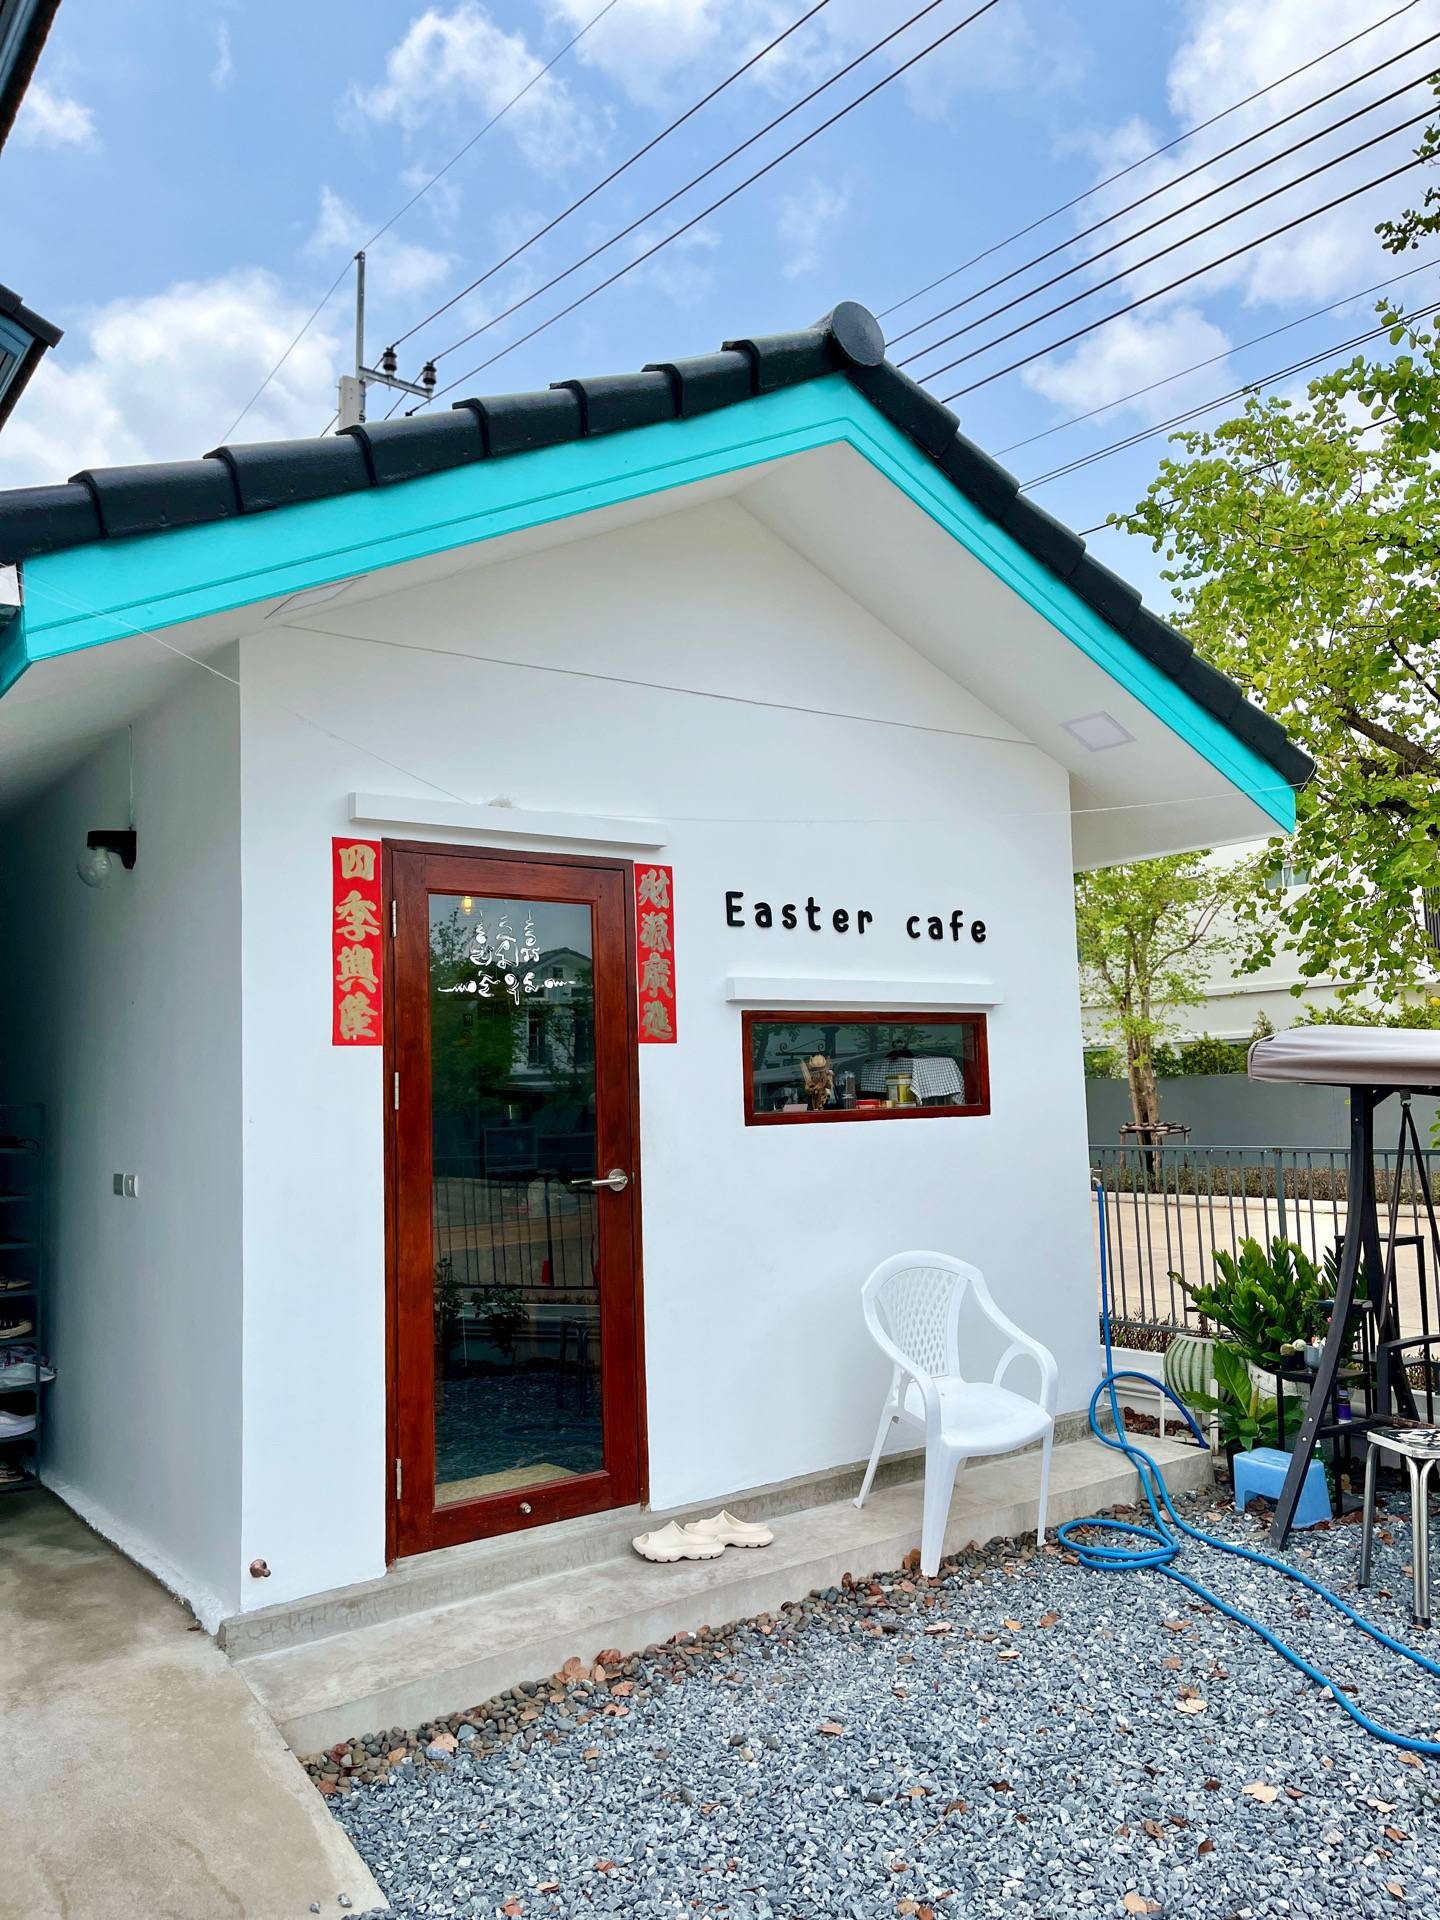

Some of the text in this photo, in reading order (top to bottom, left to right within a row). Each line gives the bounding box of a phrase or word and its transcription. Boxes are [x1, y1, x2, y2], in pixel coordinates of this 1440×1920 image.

[335, 844, 380, 1040] 四季興隆
[726, 891, 987, 943] Easter cafe
